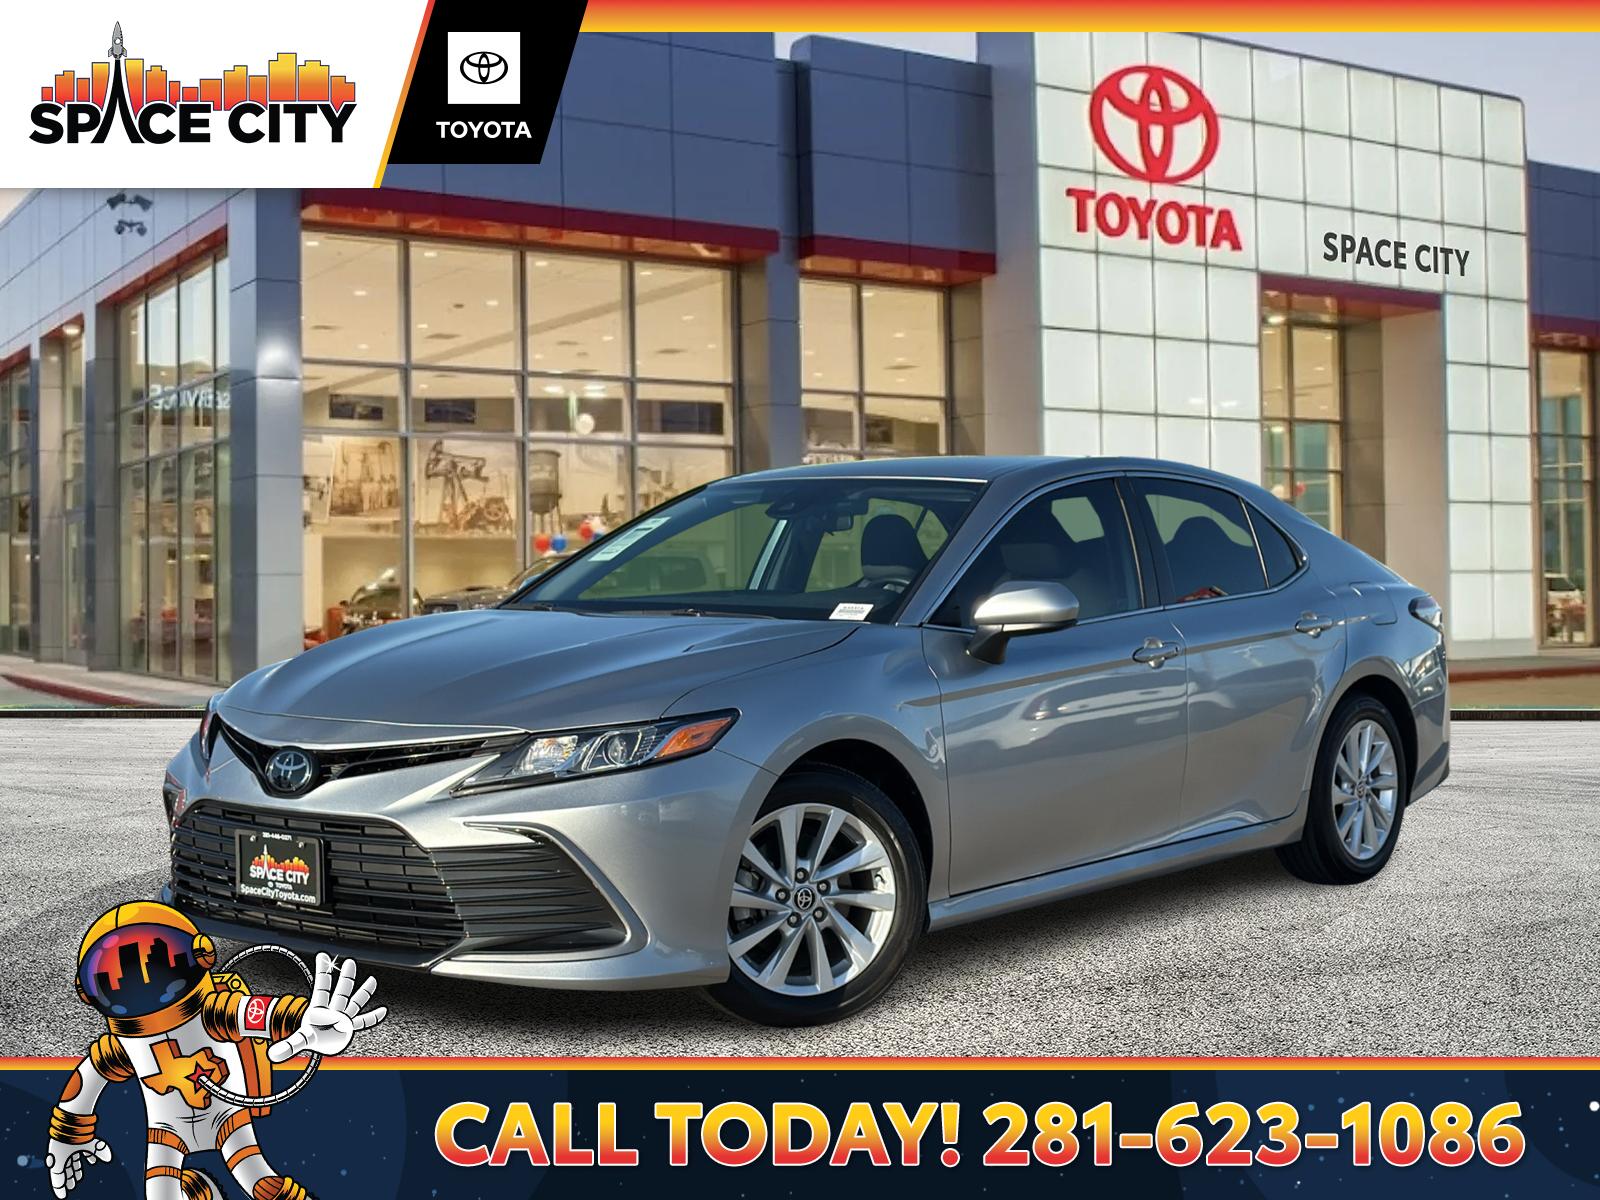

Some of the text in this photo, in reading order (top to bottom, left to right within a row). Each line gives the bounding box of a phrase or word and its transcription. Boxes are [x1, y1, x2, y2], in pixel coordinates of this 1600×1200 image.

[1066, 187, 1242, 251] TOYOTA
[1323, 232, 1470, 277] SPACE CITY
[249, 864, 310, 886] SPACE CITY
[240, 883, 316, 904] SpaceCityToyota.com
